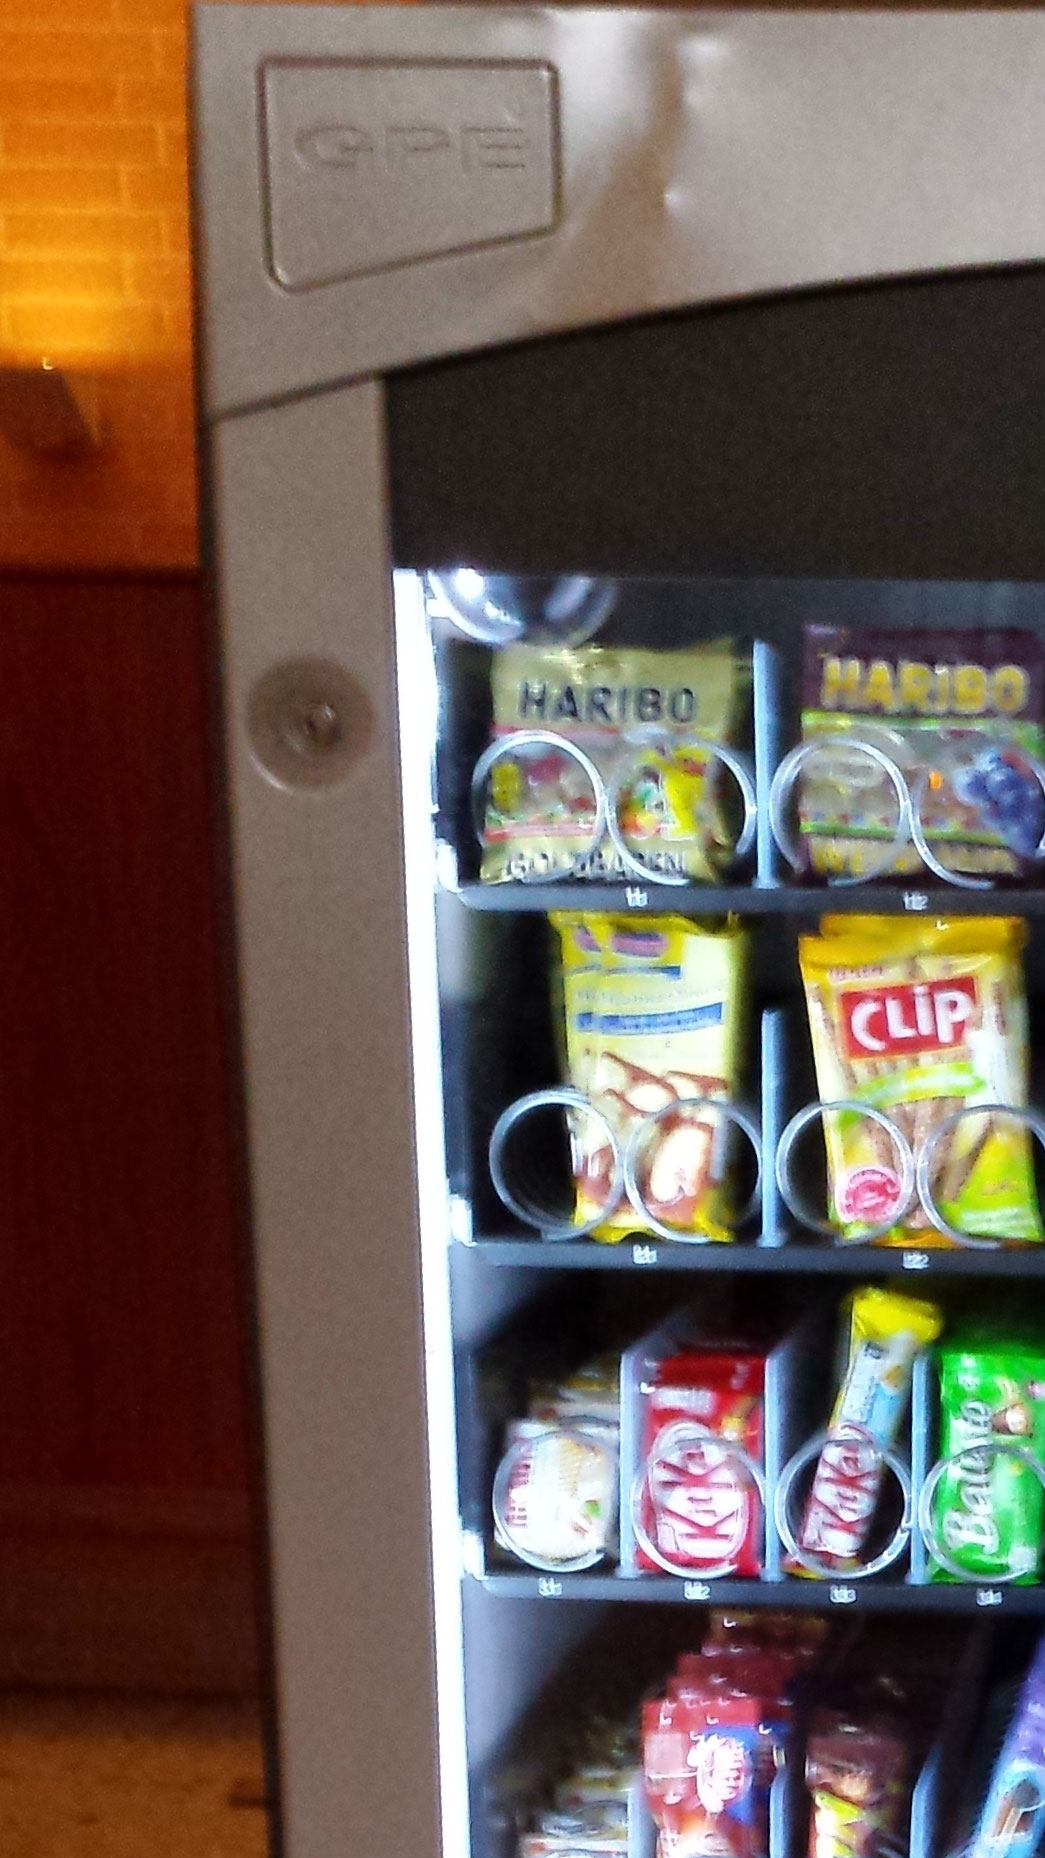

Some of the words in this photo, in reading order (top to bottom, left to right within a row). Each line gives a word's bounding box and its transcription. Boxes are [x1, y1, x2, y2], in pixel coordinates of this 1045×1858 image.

[294, 122, 530, 171] GPE
[518, 680, 697, 723] HARIBO
[820, 656, 1030, 718] HARIBO
